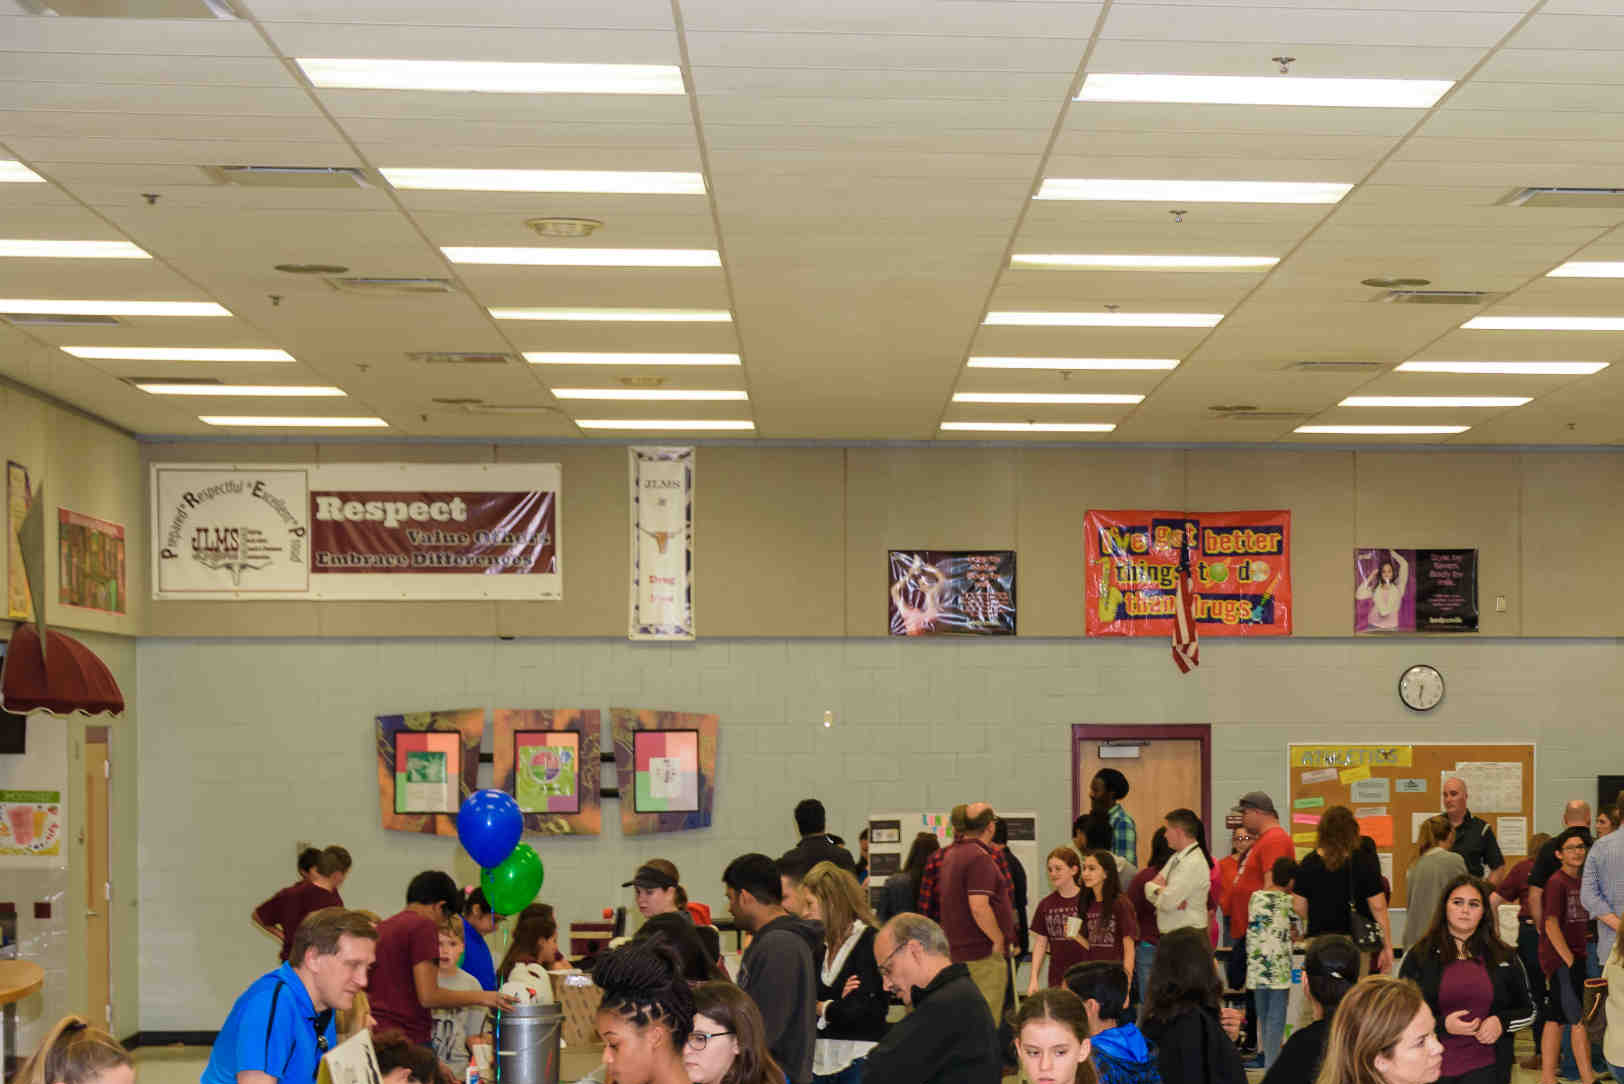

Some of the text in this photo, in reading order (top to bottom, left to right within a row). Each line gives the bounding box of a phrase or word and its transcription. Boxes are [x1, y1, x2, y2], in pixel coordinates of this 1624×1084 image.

[316, 496, 468, 529] Respect
[192, 527, 239, 552] JLMS
[407, 528, 552, 546] Value Others
[1101, 521, 1282, 555] I've got better
[315, 550, 535, 568] Embrace Differences
[1123, 588, 1176, 618] than
